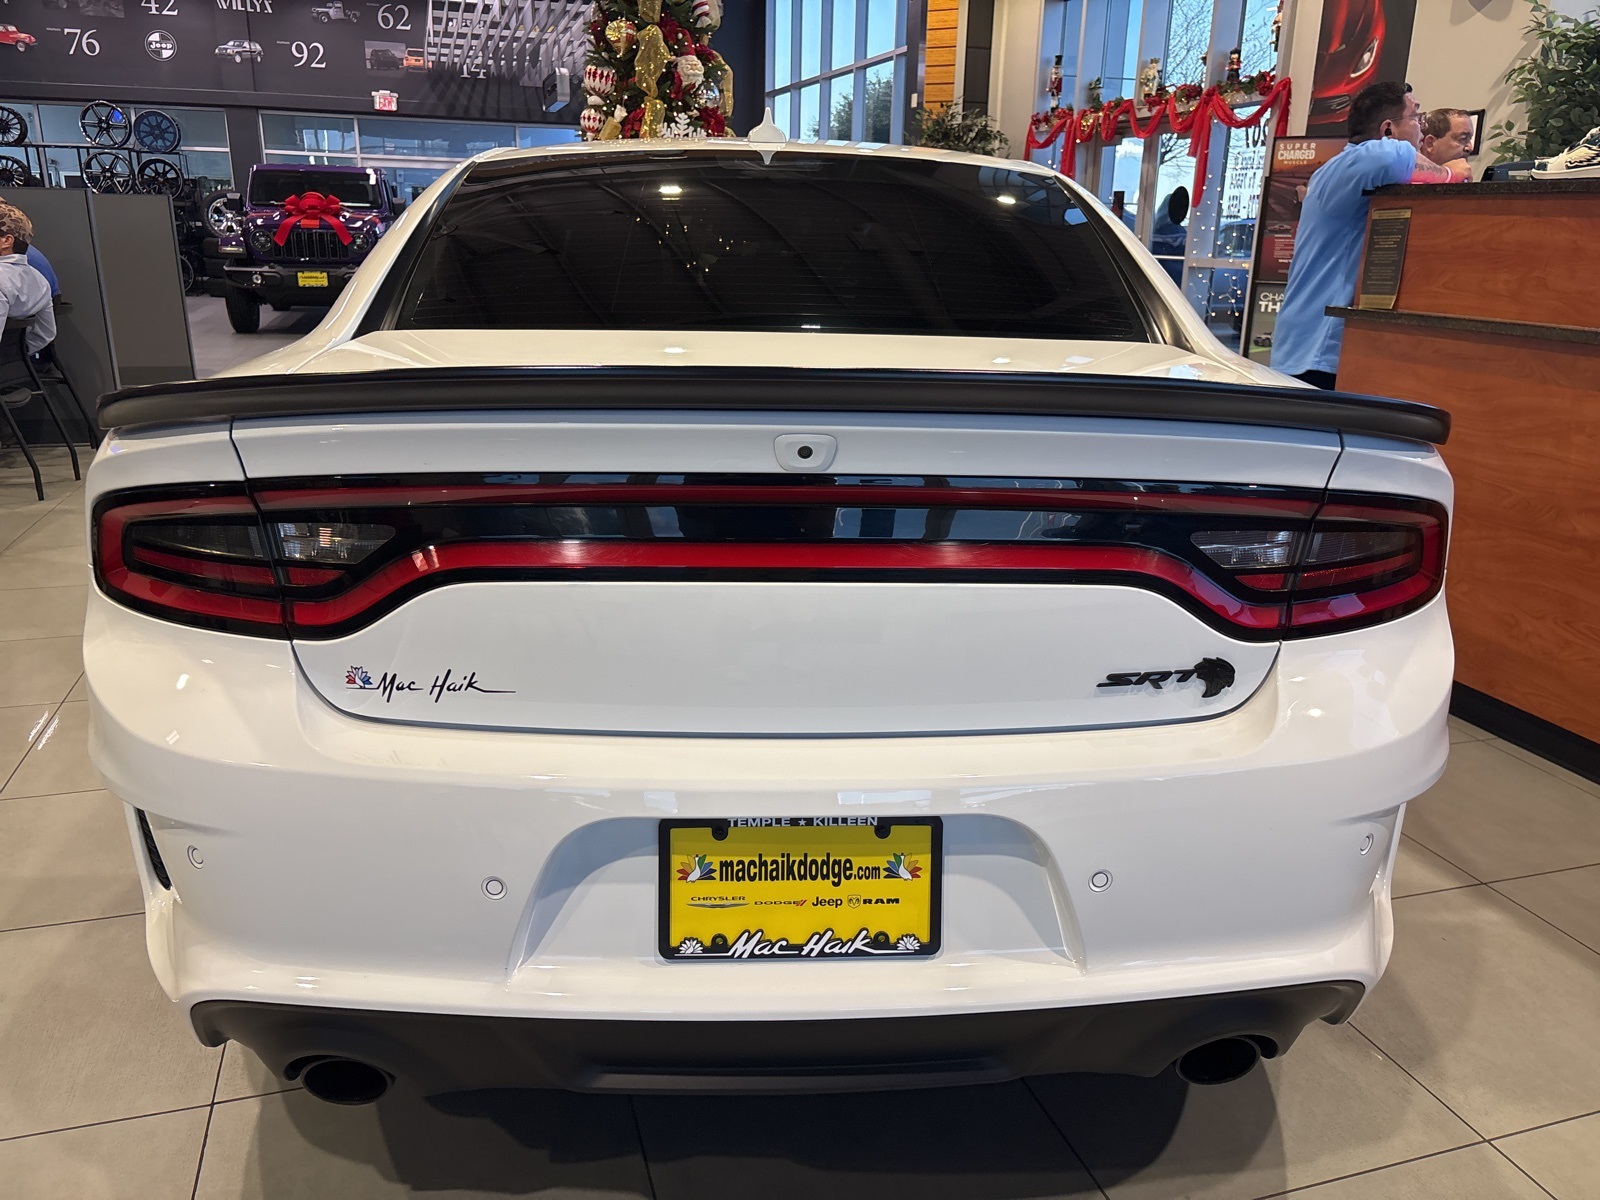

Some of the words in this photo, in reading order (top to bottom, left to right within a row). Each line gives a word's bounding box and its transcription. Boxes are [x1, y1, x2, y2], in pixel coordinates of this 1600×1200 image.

[140, 0, 178, 15] 42
[377, 4, 412, 31] 62
[64, 28, 100, 56] 76
[150, 42, 173, 50] Jeep
[291, 41, 327, 69] 92
[1279, 142, 1317, 150] SUPER
[1278, 150, 1316, 160] CHARGED
[1258, 301, 1283, 312] TH
[377, 672, 423, 703] Mac
[429, 669, 505, 703] Haik
[1096, 669, 1198, 690] SRT
[727, 818, 791, 828] TEMPLE
[813, 816, 878, 826] KILLEEN
[719, 852, 881, 888] machaikdodge.com
[811, 896, 843, 908] Jeep
[862, 897, 900, 905] RAM
[728, 931, 799, 959] Mac
[801, 929, 880, 957] Haik
